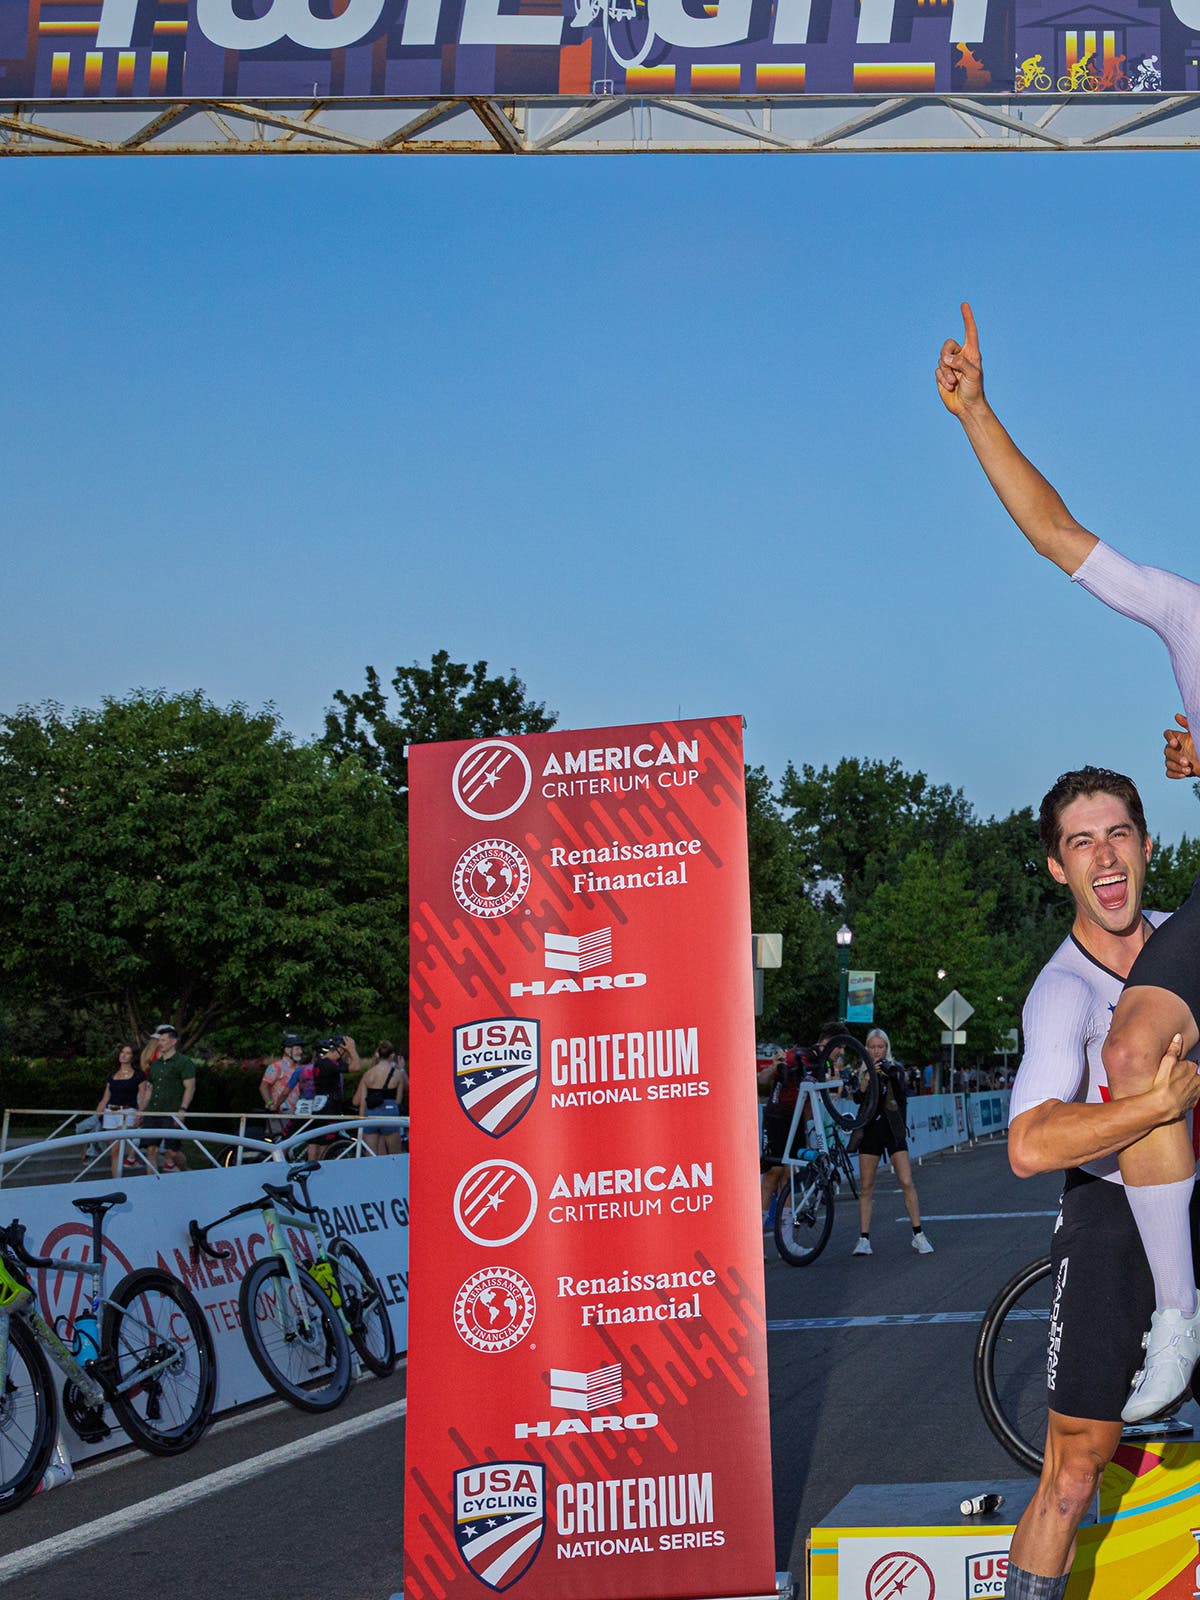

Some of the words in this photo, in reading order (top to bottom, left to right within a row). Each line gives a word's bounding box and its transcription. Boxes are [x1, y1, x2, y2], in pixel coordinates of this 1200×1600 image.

[542, 740, 699, 777] AMERICAN
[542, 775, 649, 799] CRITERIUM
[657, 770, 699, 788] CUP
[465, 850, 518, 875] RENAISSANCE
[550, 839, 702, 867] Renaissance
[573, 862, 688, 894] Financial
[469, 890, 515, 908] FINANCIAL
[510, 973, 647, 997] HARO
[462, 1025, 532, 1050] USA
[462, 1049, 532, 1066] CYCLING
[550, 1027, 699, 1087] CRITERIUM
[551, 1089, 642, 1108] NATIONAL
[647, 1081, 710, 1100] SERIES
[548, 1162, 714, 1200] AMERICAN
[317, 1201, 389, 1239] BAILEY
[548, 1199, 662, 1223] CRITERIUM
[670, 1194, 713, 1214] CUP
[467, 1278, 523, 1304] RENAISSANCE
[557, 1268, 716, 1297] Renaissance
[581, 1294, 702, 1327] Financial
[470, 1323, 519, 1342] FINANCIAL
[1051, 1321, 1064, 1391] TEAM
[515, 1413, 658, 1439] HARO
[463, 1469, 537, 1494] USA
[463, 1496, 537, 1513] CYCLING
[556, 1472, 714, 1536] CRITERIUM
[557, 1538, 654, 1560] NATIONAL
[659, 1530, 725, 1551] SERIES
[974, 1558, 1009, 1580] US
